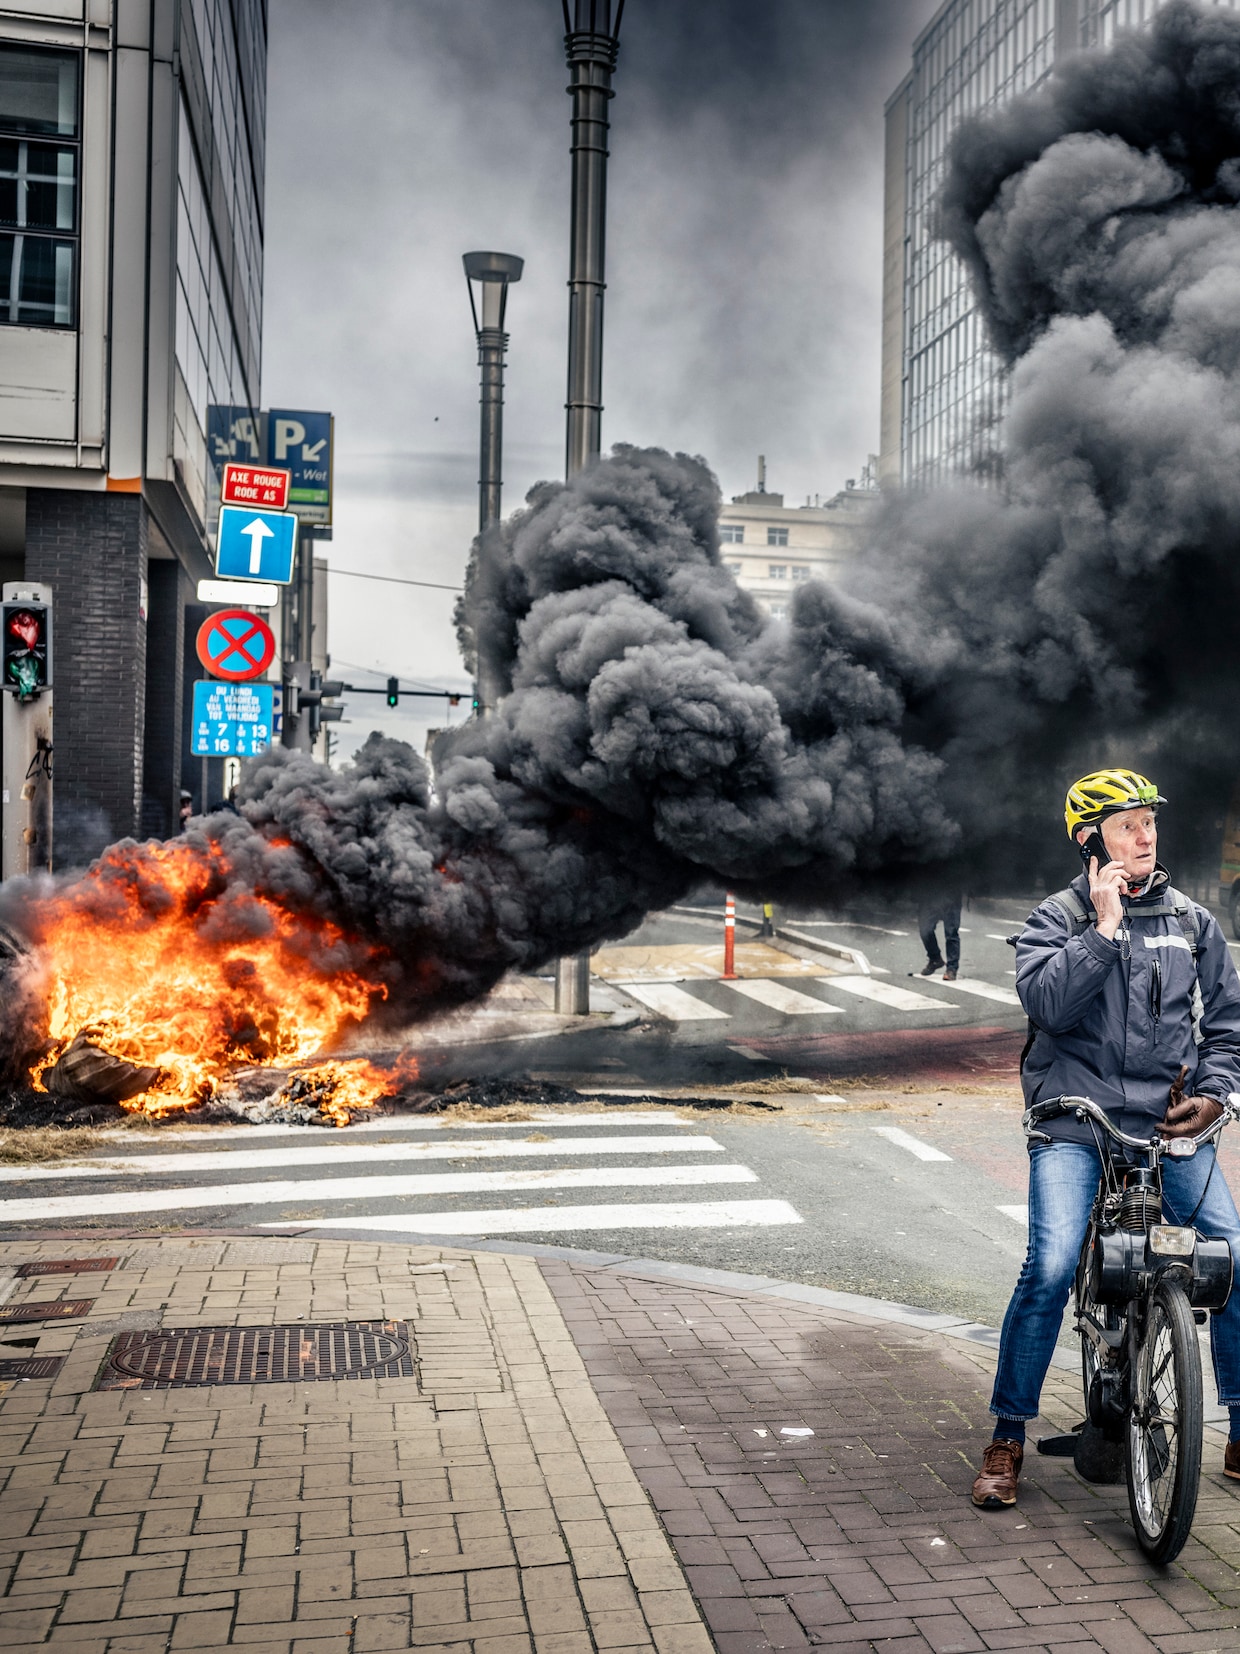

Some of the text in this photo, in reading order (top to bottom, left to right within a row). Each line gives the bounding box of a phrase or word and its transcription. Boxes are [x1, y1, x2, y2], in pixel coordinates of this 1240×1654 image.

[275, 419, 306, 460] P
[229, 471, 283, 489] AXE ROUGE
[303, 468, 328, 482] Wet
[234, 486, 259, 499] RODE
[263, 490, 276, 502] AS
[215, 685, 253, 696] DU LUNDI
[223, 695, 260, 705] VENDREDI
[206, 702, 261, 714] VAN MAANDAG
[208, 710, 223, 720] TOT
[217, 722, 228, 737] 7
[252, 724, 267, 738] 13
[214, 738, 230, 752] 16
